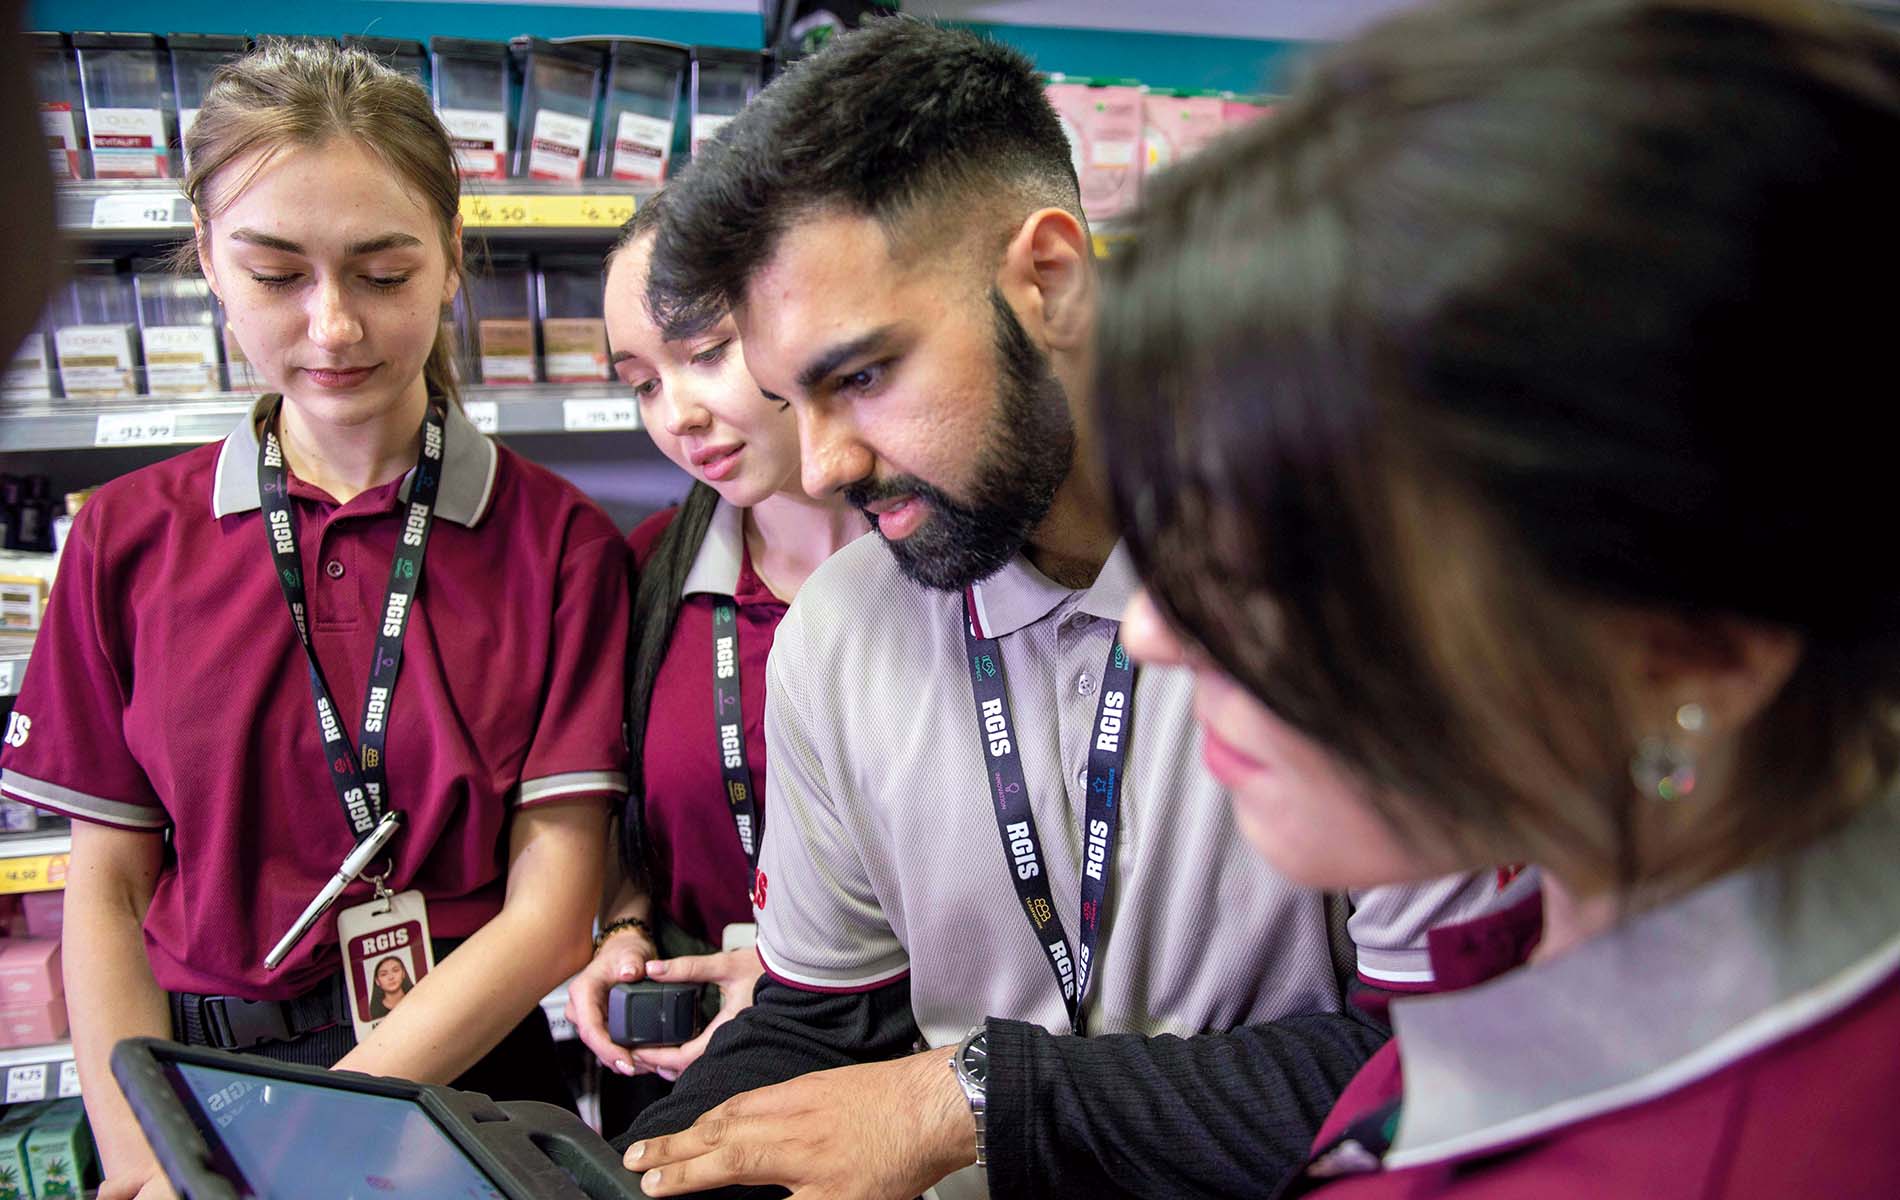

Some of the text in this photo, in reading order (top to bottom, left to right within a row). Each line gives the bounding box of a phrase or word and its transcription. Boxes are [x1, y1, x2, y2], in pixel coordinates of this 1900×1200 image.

[264, 432, 282, 467] RGIS
[425, 421, 441, 460] RGIS
[269, 510, 294, 554] RGIS
[403, 502, 429, 546] RGIS
[383, 592, 408, 637] RGIS
[716, 636, 734, 679] RGIS
[317, 697, 341, 743] RGIS
[365, 687, 388, 733] RGIS
[981, 697, 1011, 757] RGIS
[1096, 691, 1125, 752] RGIS
[721, 724, 741, 769] RGIS
[343, 788, 374, 833] RGIS
[1006, 821, 1039, 880] RGIS
[1086, 819, 1108, 881] RGIS
[362, 928, 409, 955] RGIS
[1049, 939, 1074, 1000] RGIS
